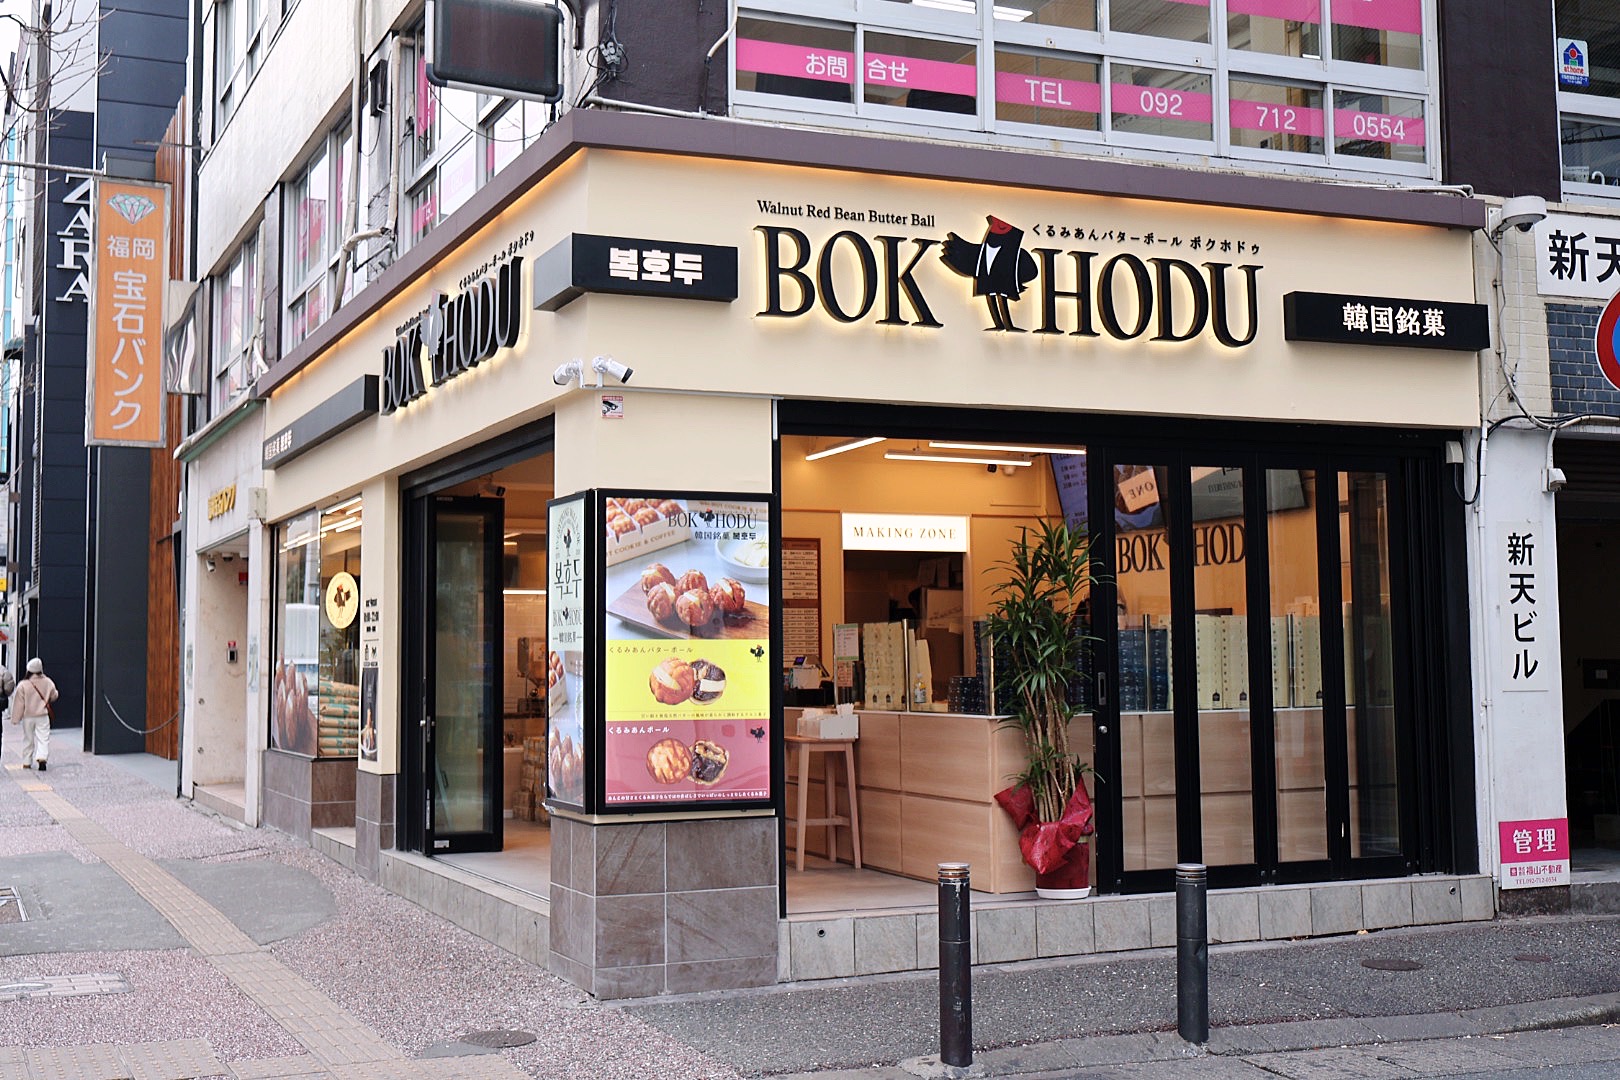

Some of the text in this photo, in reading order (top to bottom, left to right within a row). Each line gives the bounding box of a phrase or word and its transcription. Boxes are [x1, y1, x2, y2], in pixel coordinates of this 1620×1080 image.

[1024, 78, 1073, 107] TEL
[1139, 90, 1184, 117] 092
[1256, 105, 1297, 132] 712
[1353, 114, 1406, 141] 0554
[756, 199, 936, 228] Walnut Red Bean Butter Ball
[107, 234, 156, 261] 福岡
[1032, 222, 1184, 248] くるみあんバターボール
[608, 246, 704, 286] 복호두
[752, 224, 1265, 349] BOK HODU
[381, 255, 525, 416] BOK HODU
[1341, 302, 1447, 339] 韓国銘菓
[110, 268, 148, 431] 宝石バンク
[667, 511, 758, 530] BOK HODU
[853, 526, 957, 540] MAKING ZONE
[1116, 521, 1246, 575] BOK HOD
[553, 558, 583, 601] 복호두
[1506, 531, 1540, 681] 新天ビル
[607, 726, 671, 735] くるみあんボール
[1512, 827, 1557, 854] 管理
